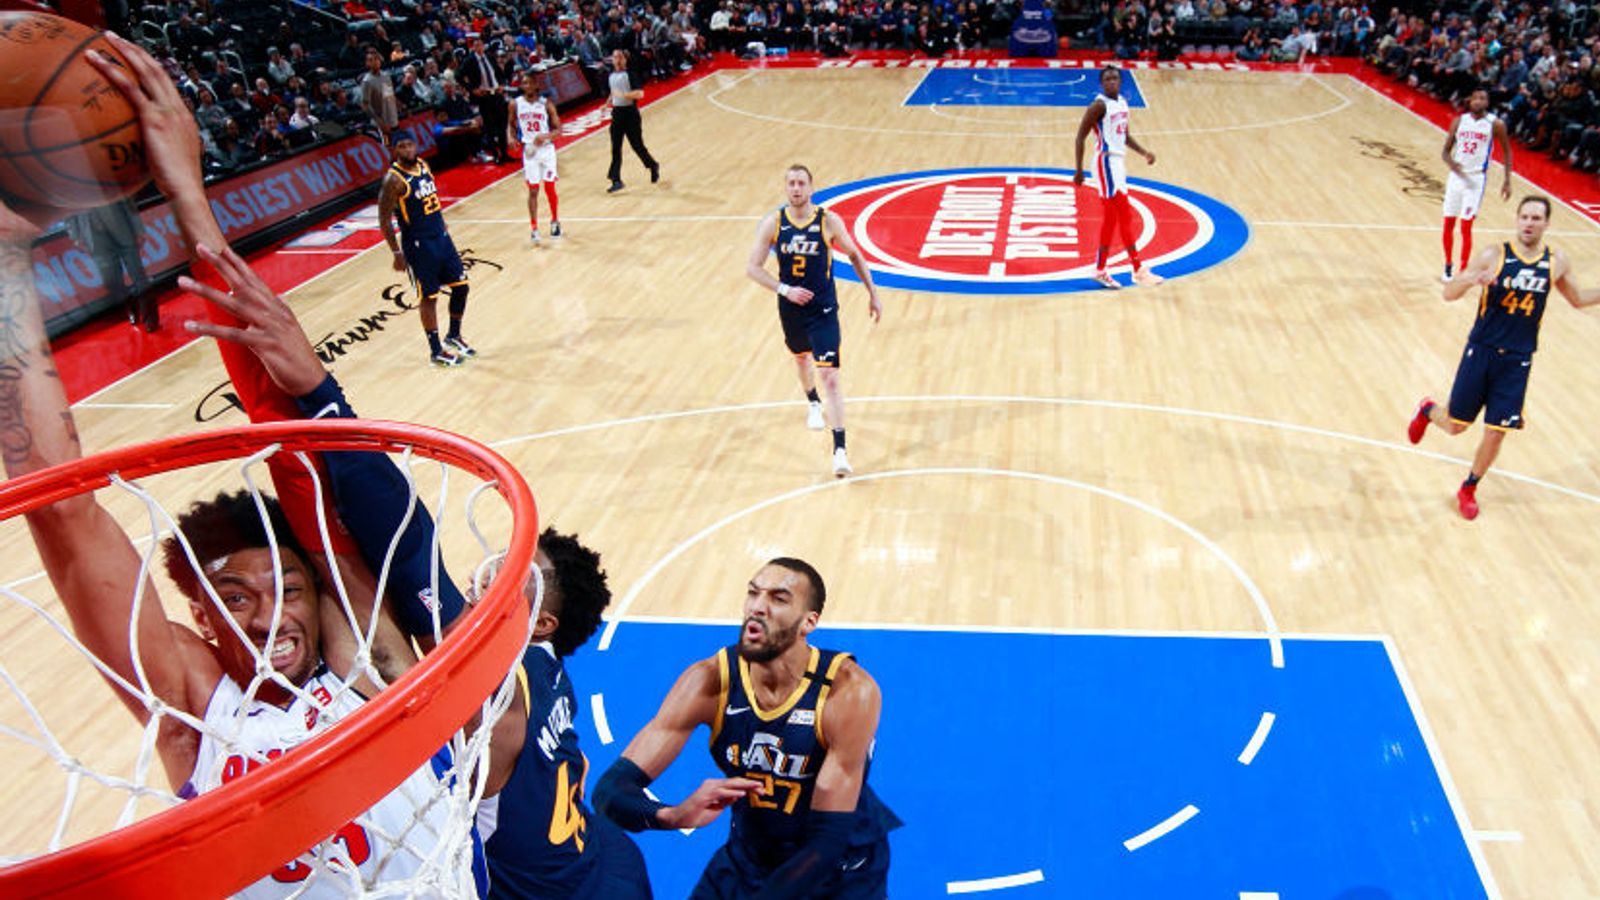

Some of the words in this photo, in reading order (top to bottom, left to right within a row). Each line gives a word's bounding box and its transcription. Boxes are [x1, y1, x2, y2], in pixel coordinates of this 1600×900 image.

[209, 172, 292, 234] ASIEST
[294, 151, 353, 197] WAY
[351, 141, 384, 177] TO
[422, 193, 442, 215] 23
[918, 184, 1005, 259] DETROIT
[1004, 184, 1080, 260] PISTONS
[781, 235, 820, 255] JAZZ
[792, 255, 806, 277] 2
[1503, 268, 1548, 293] JAZZ
[1501, 291, 1536, 317] 44
[726, 732, 816, 780] JAZZ
[746, 772, 802, 815] 27
